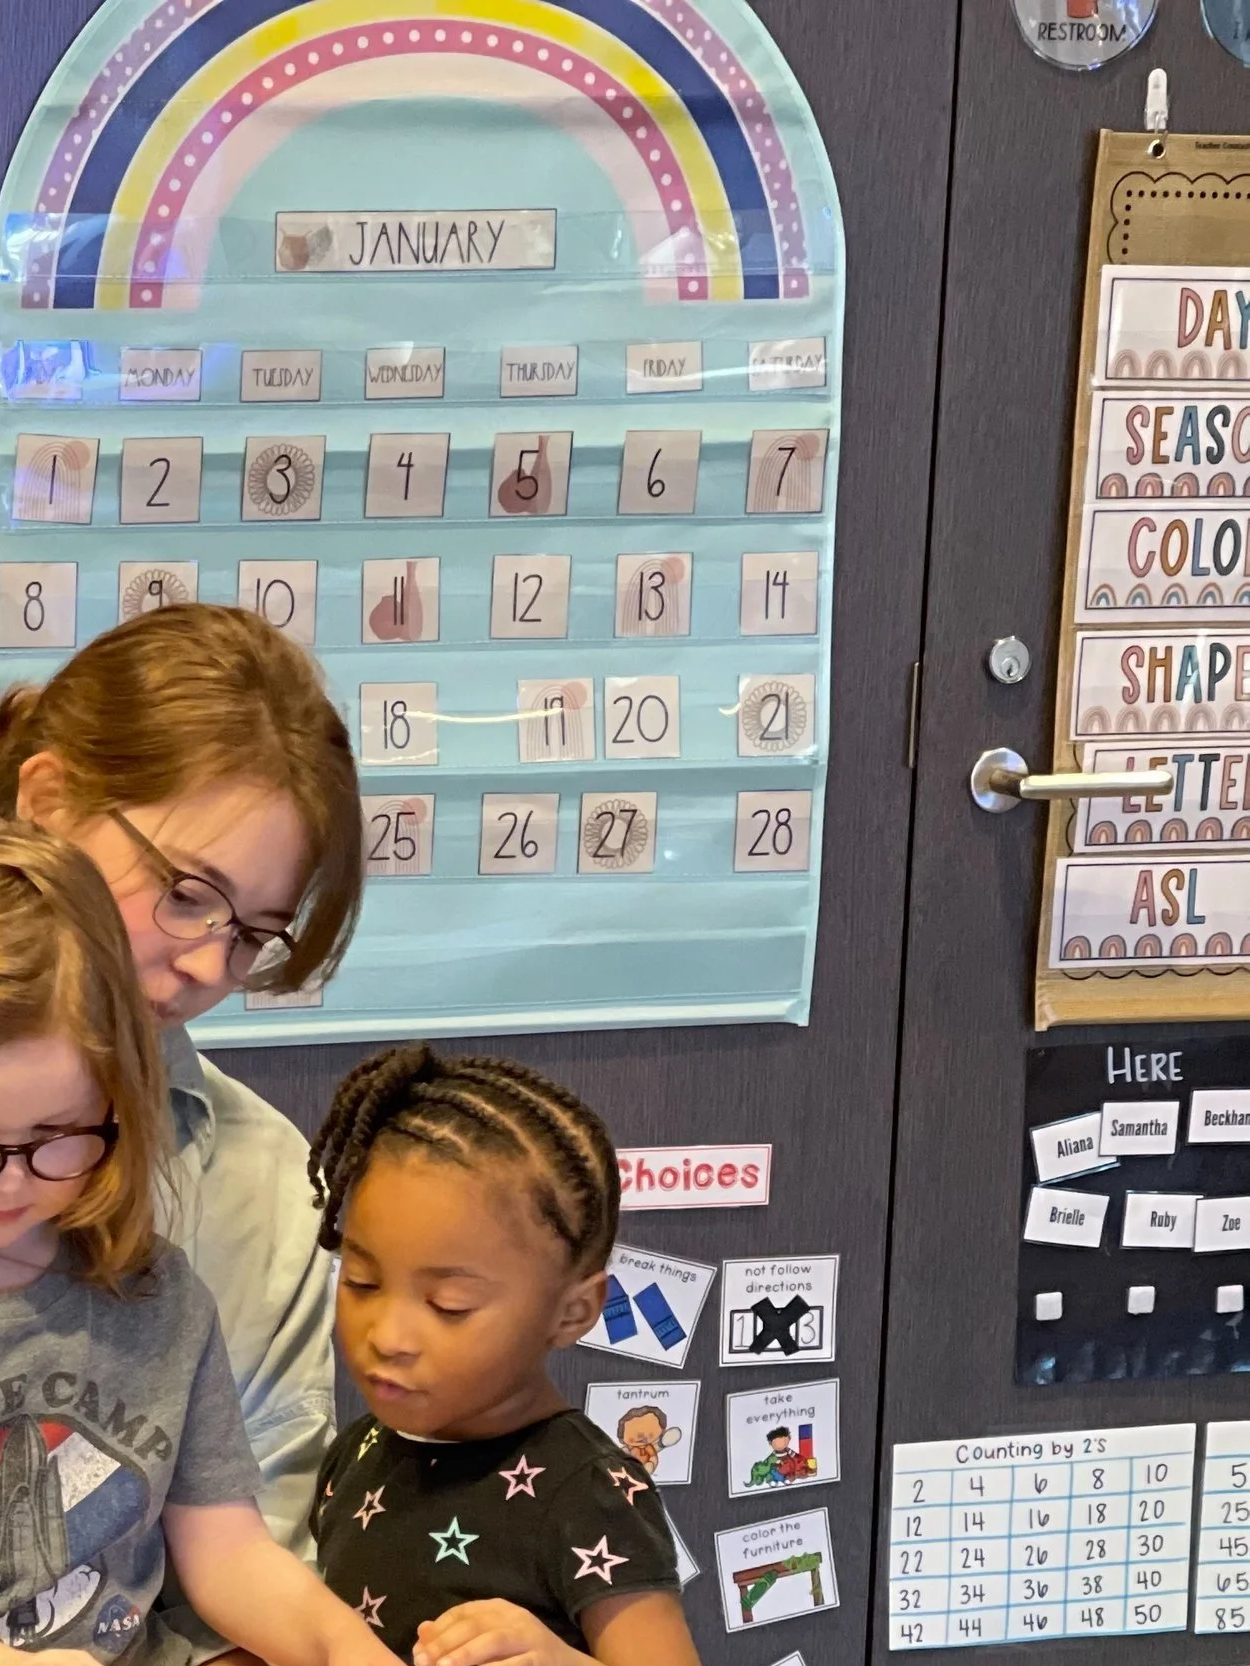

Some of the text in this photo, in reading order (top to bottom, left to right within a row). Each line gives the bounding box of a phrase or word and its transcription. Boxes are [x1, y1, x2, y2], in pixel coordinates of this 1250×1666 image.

[350, 220, 505, 266] JANUARY
[124, 367, 195, 388] MONDAY
[252, 367, 314, 387] TUESDAY
[369, 363, 443, 384] WEDNESDAY
[506, 360, 575, 382] THURSDAY
[644, 357, 687, 378] FRIDAY
[50, 446, 796, 507] 1 2 3 4 5 6 7
[1127, 516, 1250, 578] COLO
[23, 581, 45, 631] 8
[255, 577, 295, 628] 10
[393, 576, 404, 627] 11
[512, 572, 544, 622] 12
[637, 570, 665, 621] 13
[764, 569, 789, 619] 14
[383, 700, 411, 749] 18
[611, 694, 669, 744] 20
[758, 690, 790, 742] 21
[1121, 753, 1250, 813] LETTE
[367, 807, 793, 861] 25 26 27 28
[1128, 867, 1206, 927] ASL
[1107, 1046, 1184, 1085] HERE
[1111, 1119, 1168, 1138] Samantha
[1056, 1135, 1094, 1159] Aliana
[1049, 1205, 1086, 1227] Brielle
[1150, 1210, 1177, 1232] Ruby
[1222, 1214, 1240, 1232] Zoe
[619, 1253, 697, 1283] break things
[745, 1264, 812, 1277] not follow
[746, 1280, 812, 1294] directions
[617, 1387, 670, 1400] tantrum
[764, 1391, 793, 1406] take
[41, 1371, 174, 1462] CAMP
[745, 1404, 816, 1426] everything
[955, 1442, 1043, 1464] Counting
[1052, 1440, 1074, 1458] by
[913, 1463, 1168, 1504] 2 4 6 8 10
[1231, 1462, 1248, 1488] 5
[906, 1499, 1165, 1538] 12 14 16 18 20
[1221, 1500, 1250, 1524] 25
[742, 1520, 801, 1544] color the
[742, 1535, 804, 1560] furniture
[900, 1534, 1164, 1575] 22 24 26 28 30
[1219, 1536, 1248, 1558] 45
[899, 1570, 1162, 1611] 32 34 36 38 40
[1216, 1571, 1249, 1593] 65
[97, 1613, 141, 1635] NASA
[900, 1603, 1162, 1644] 42 44 46 48 50
[1215, 1605, 1245, 1631] 85
